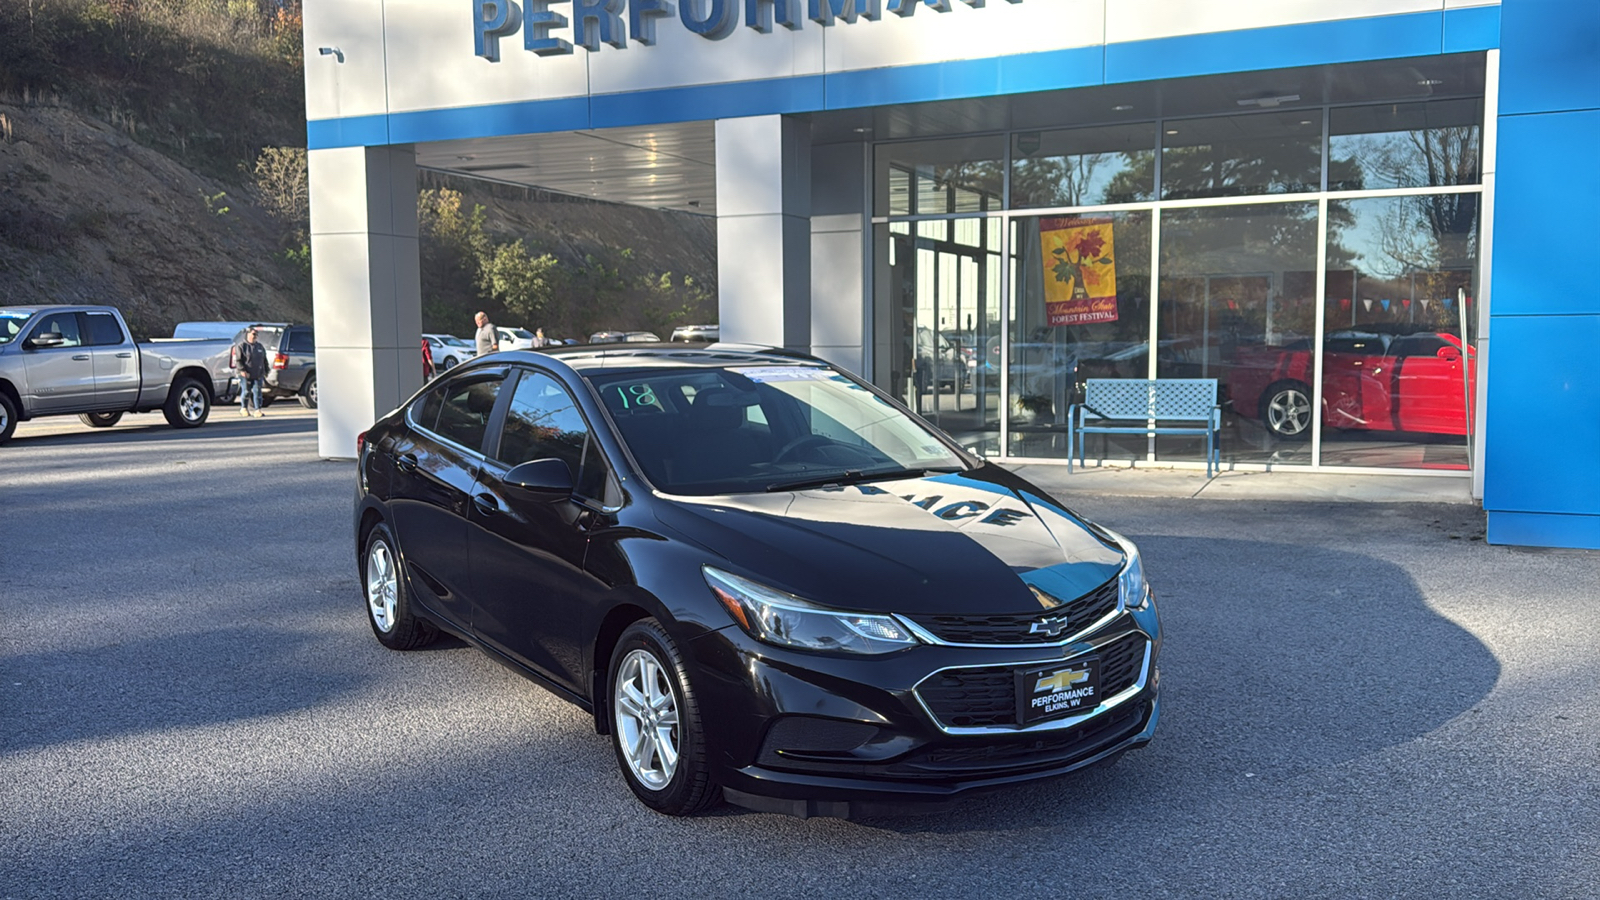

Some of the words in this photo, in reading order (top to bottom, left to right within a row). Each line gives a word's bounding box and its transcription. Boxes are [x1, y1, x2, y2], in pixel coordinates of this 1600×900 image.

[1052, 313, 1079, 323] FOREST
[1080, 311, 1115, 321] FESTIVAL
[617, 384, 656, 409] 18
[1032, 686, 1094, 707] PERFORMANCE
[1045, 701, 1070, 712] ELKINS,
[1070, 699, 1081, 707] WV
